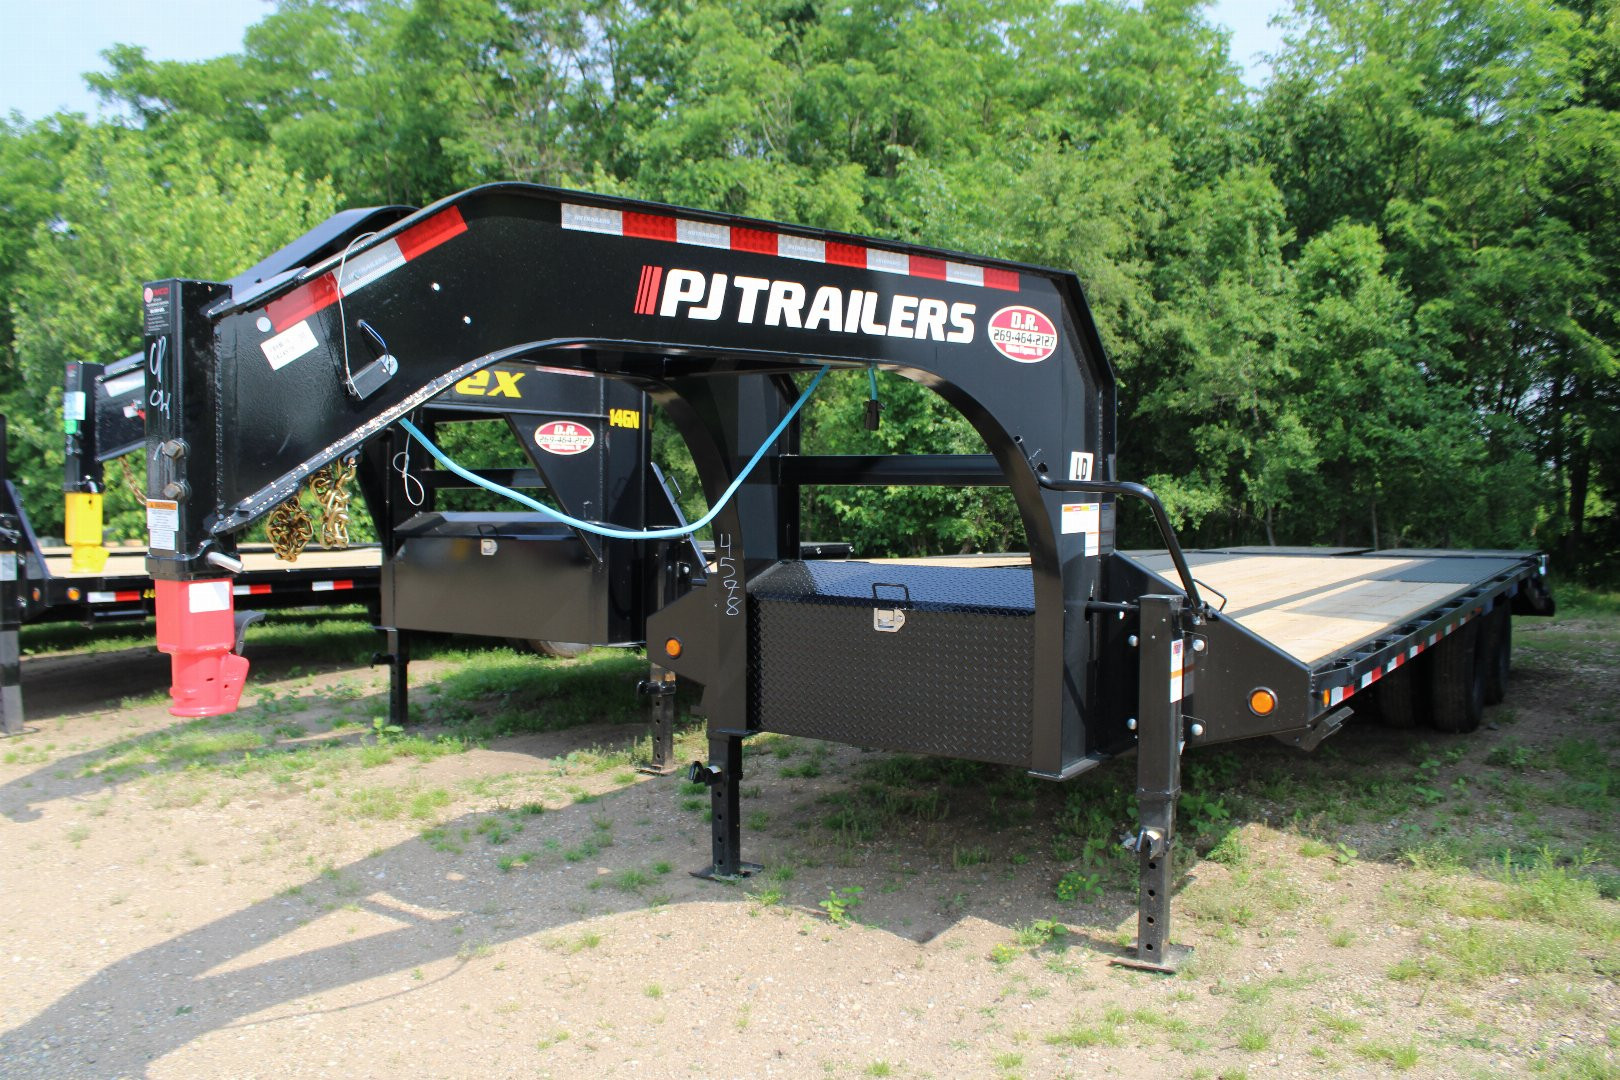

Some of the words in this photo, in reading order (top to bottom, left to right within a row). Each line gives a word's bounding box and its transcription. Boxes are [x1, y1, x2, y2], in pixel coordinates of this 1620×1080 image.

[660, 268, 728, 321] PJ
[733, 275, 977, 344] TRAILERS
[1010, 311, 1039, 331] D.R.
